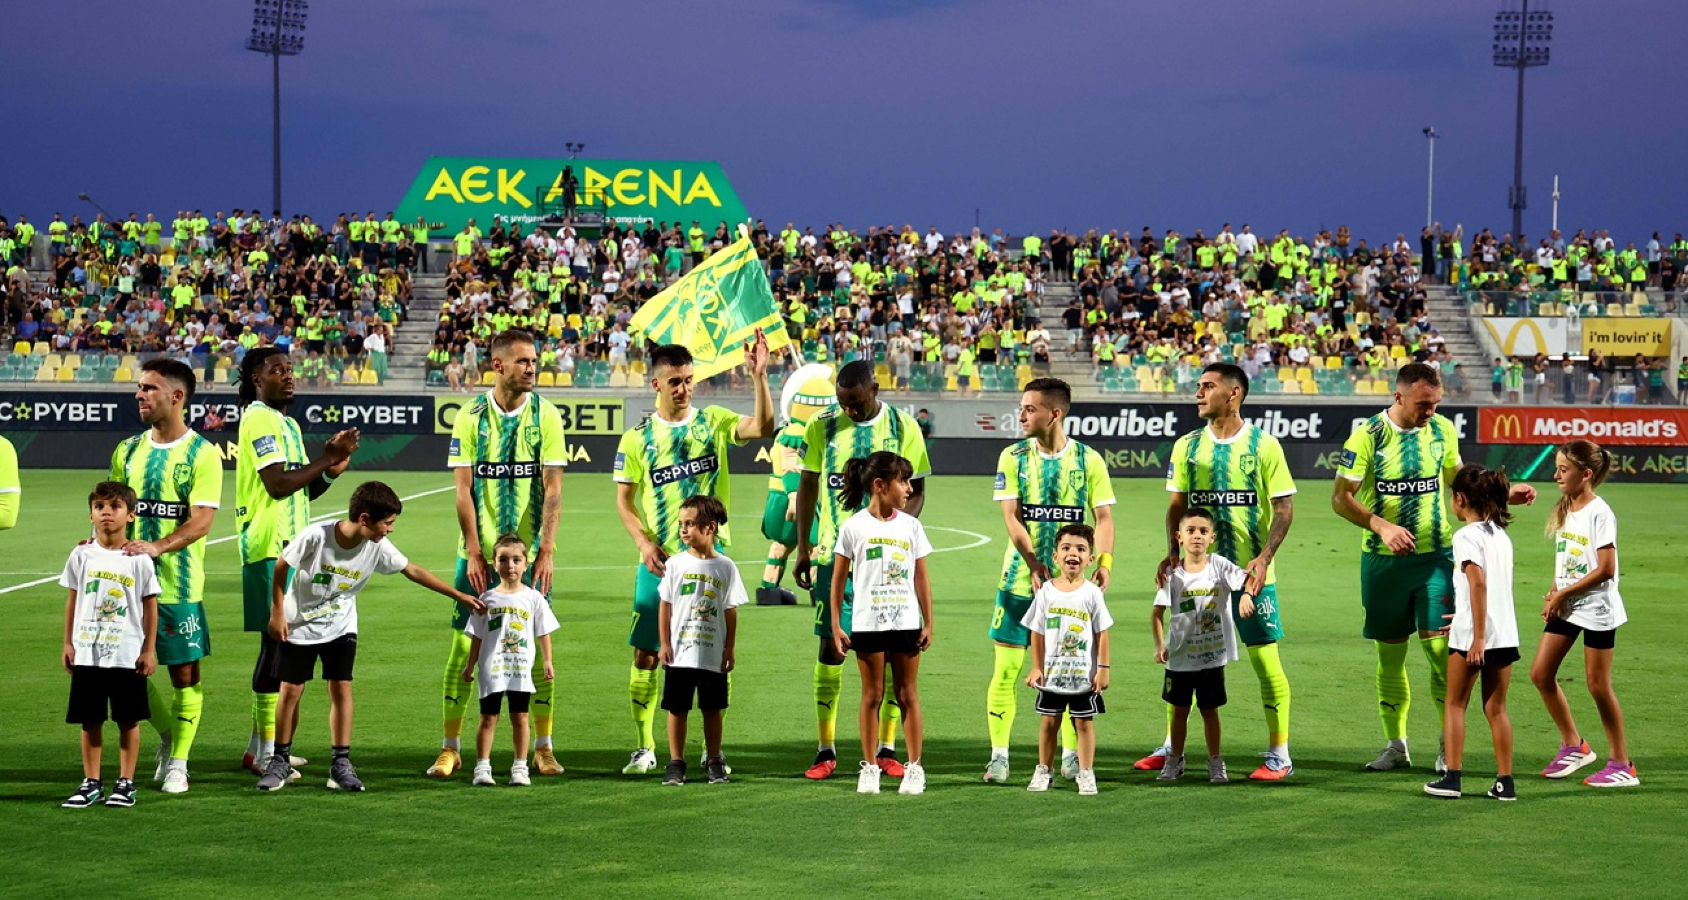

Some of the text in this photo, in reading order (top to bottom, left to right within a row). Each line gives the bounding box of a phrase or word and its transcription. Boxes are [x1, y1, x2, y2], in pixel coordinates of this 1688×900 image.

[424, 165, 723, 209] AEK ARENA
[1589, 331, 1662, 343] i'm lovin' it
[1063, 408, 1178, 437] novibet
[1533, 418, 1678, 438] McDonald's
[1104, 448, 1162, 469] RENA
[1641, 453, 1688, 474] AREN
[178, 613, 201, 640] ajk
